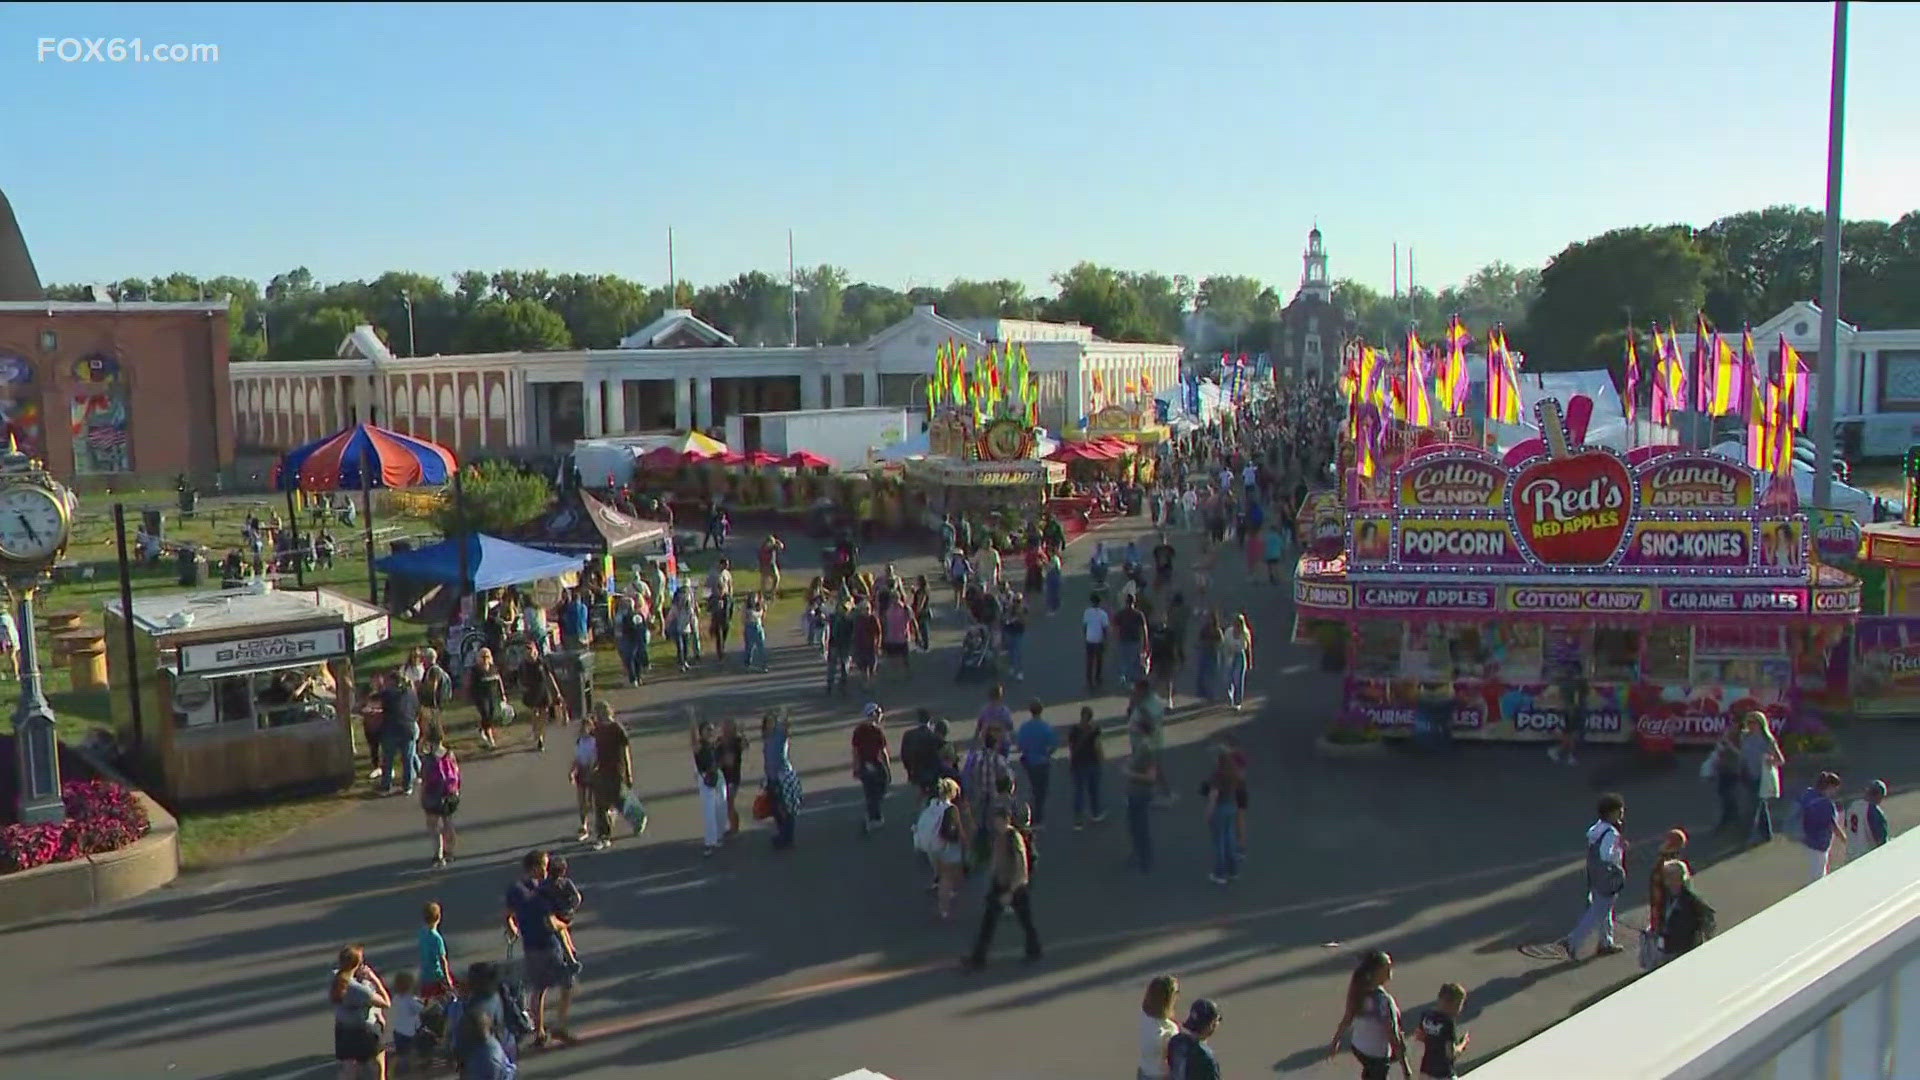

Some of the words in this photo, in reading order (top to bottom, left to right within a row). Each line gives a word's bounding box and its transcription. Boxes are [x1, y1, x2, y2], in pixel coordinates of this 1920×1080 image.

[1414, 464, 1493, 489] Cotton
[1651, 465, 1736, 492] Candy
[1416, 490, 1490, 505] CANDY
[1521, 476, 1623, 522] Red's
[1651, 491, 1735, 506] APPLES
[1531, 521, 1562, 539] RED
[1563, 511, 1619, 535] APPLES
[1404, 530, 1504, 556] POPCORN
[1641, 533, 1742, 557] SNO-KONES
[1365, 589, 1419, 604] CANDY
[1426, 590, 1488, 606] APPLES
[1514, 591, 1579, 607] COTTON
[1586, 592, 1642, 608] CANDY
[1669, 593, 1734, 608] CARAMEL
[1743, 593, 1798, 610] APPLES
[1817, 593, 1846, 609] COLD
[1672, 716, 1726, 733] OTTON
